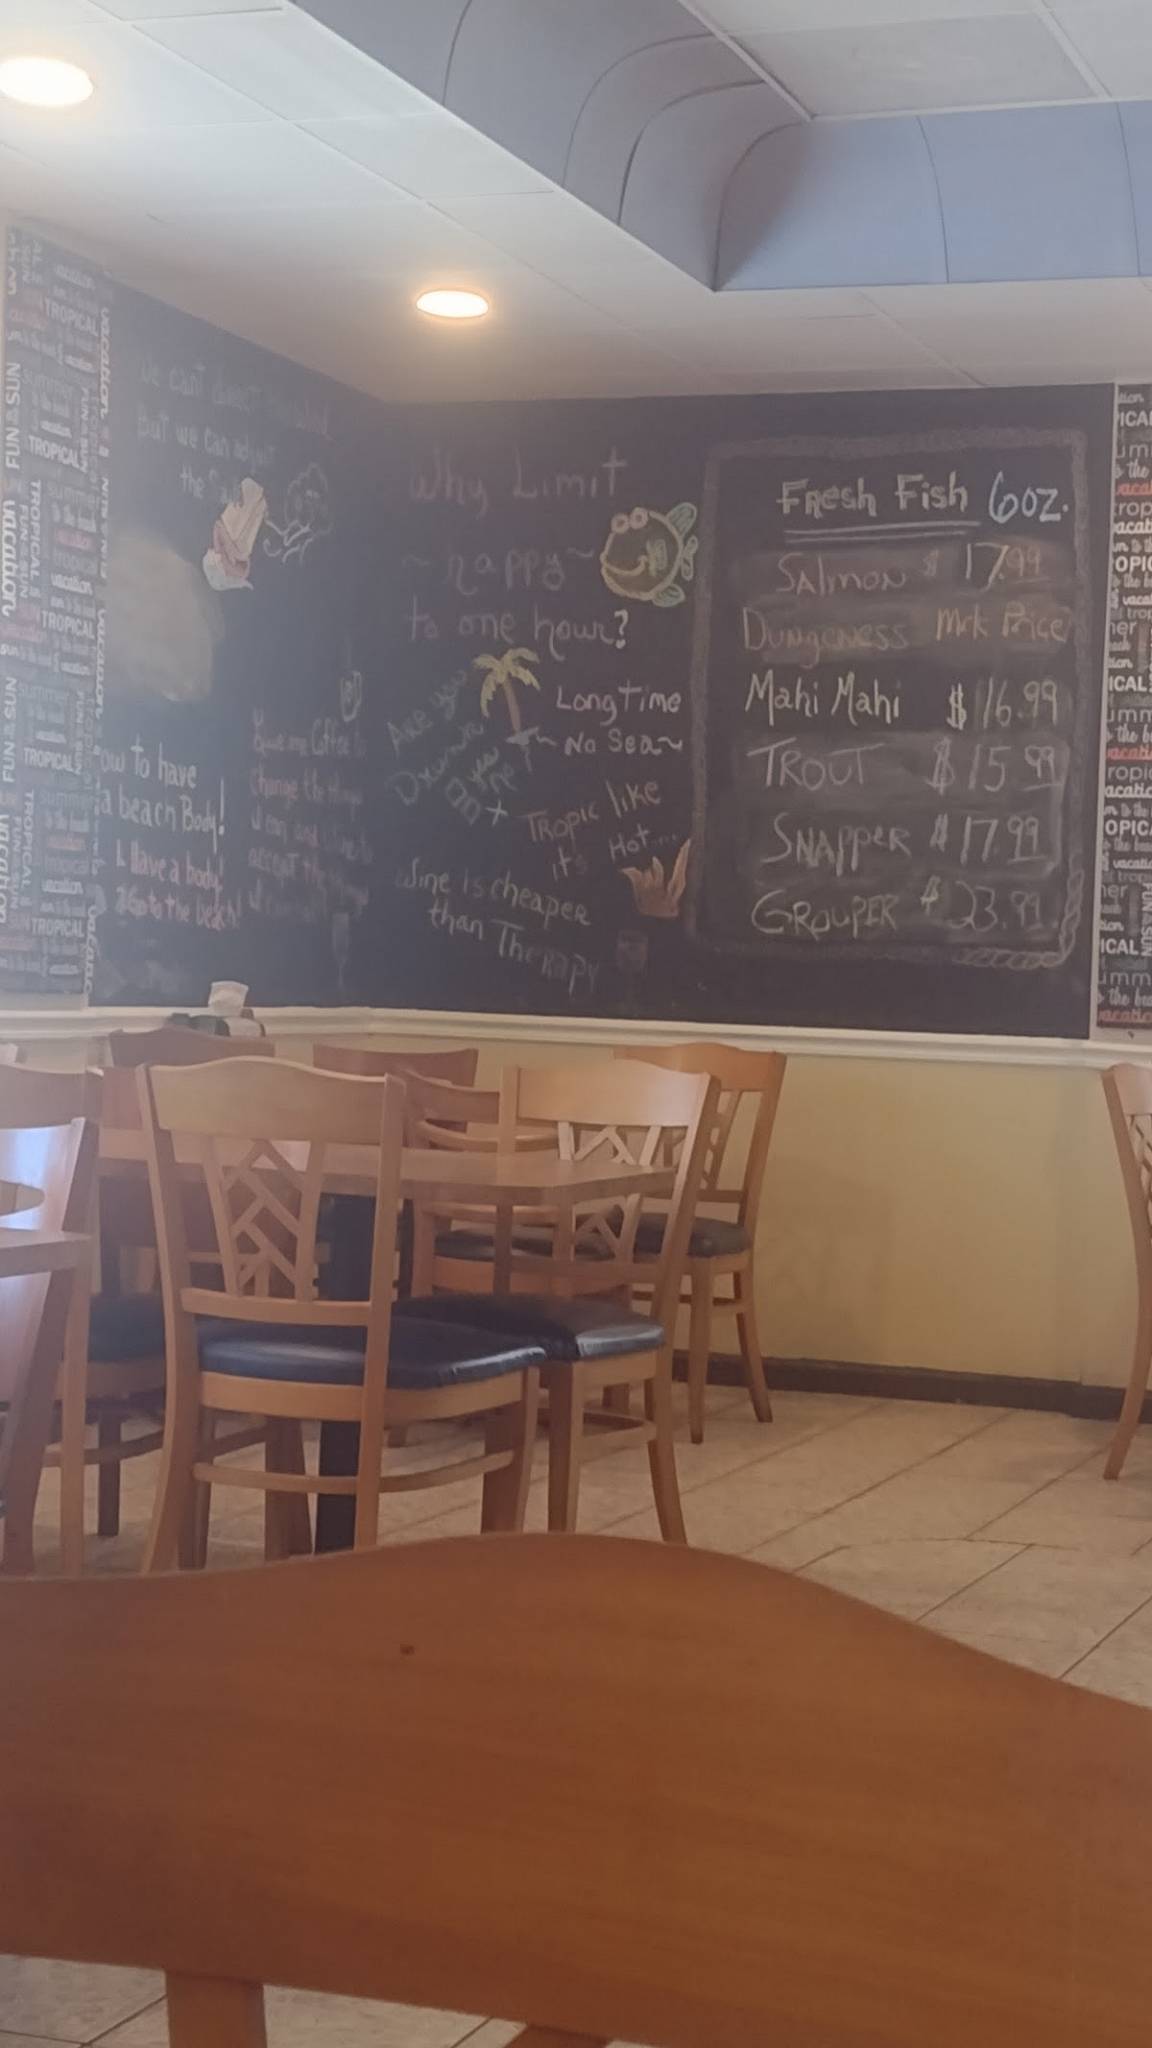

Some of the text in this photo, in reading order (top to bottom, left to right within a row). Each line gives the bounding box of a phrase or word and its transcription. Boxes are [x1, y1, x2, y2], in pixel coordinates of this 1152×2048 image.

[45, 296, 99, 337] TROPICAL
[5, 361, 21, 406] SUN
[100, 307, 111, 420] vacation
[5, 426, 21, 470] FUN
[28, 434, 81, 470] TROPICAL
[894, 470, 969, 513] Fish
[18, 503, 29, 535] FUN
[29, 480, 42, 581] TROPICAL
[1, 499, 17, 617] vacation
[41, 610, 96, 640] TROPICAL
[404, 596, 630, 663] to one hour?
[95, 608, 106, 719] vacation
[1108, 674, 1148, 693] ICAL
[3, 676, 18, 721] SUN
[555, 685, 618, 727] Long
[744, 668, 820, 727] Mahi
[830, 670, 901, 728] Mahi
[564, 731, 596, 757] No
[1116, 722, 1140, 744] the
[2, 741, 17, 783] FUN
[23, 747, 76, 771] TROPICAL
[130, 733, 151, 779] to
[158, 741, 198, 789] have
[746, 735, 887, 792] TROUT
[101, 789, 113, 815] a
[118, 783, 177, 832] beach
[21, 789, 35, 889] TROPICAL
[31, 917, 84, 939] TROPICAL
[427, 898, 484, 941] than
[1101, 937, 1139, 955] ICAL
